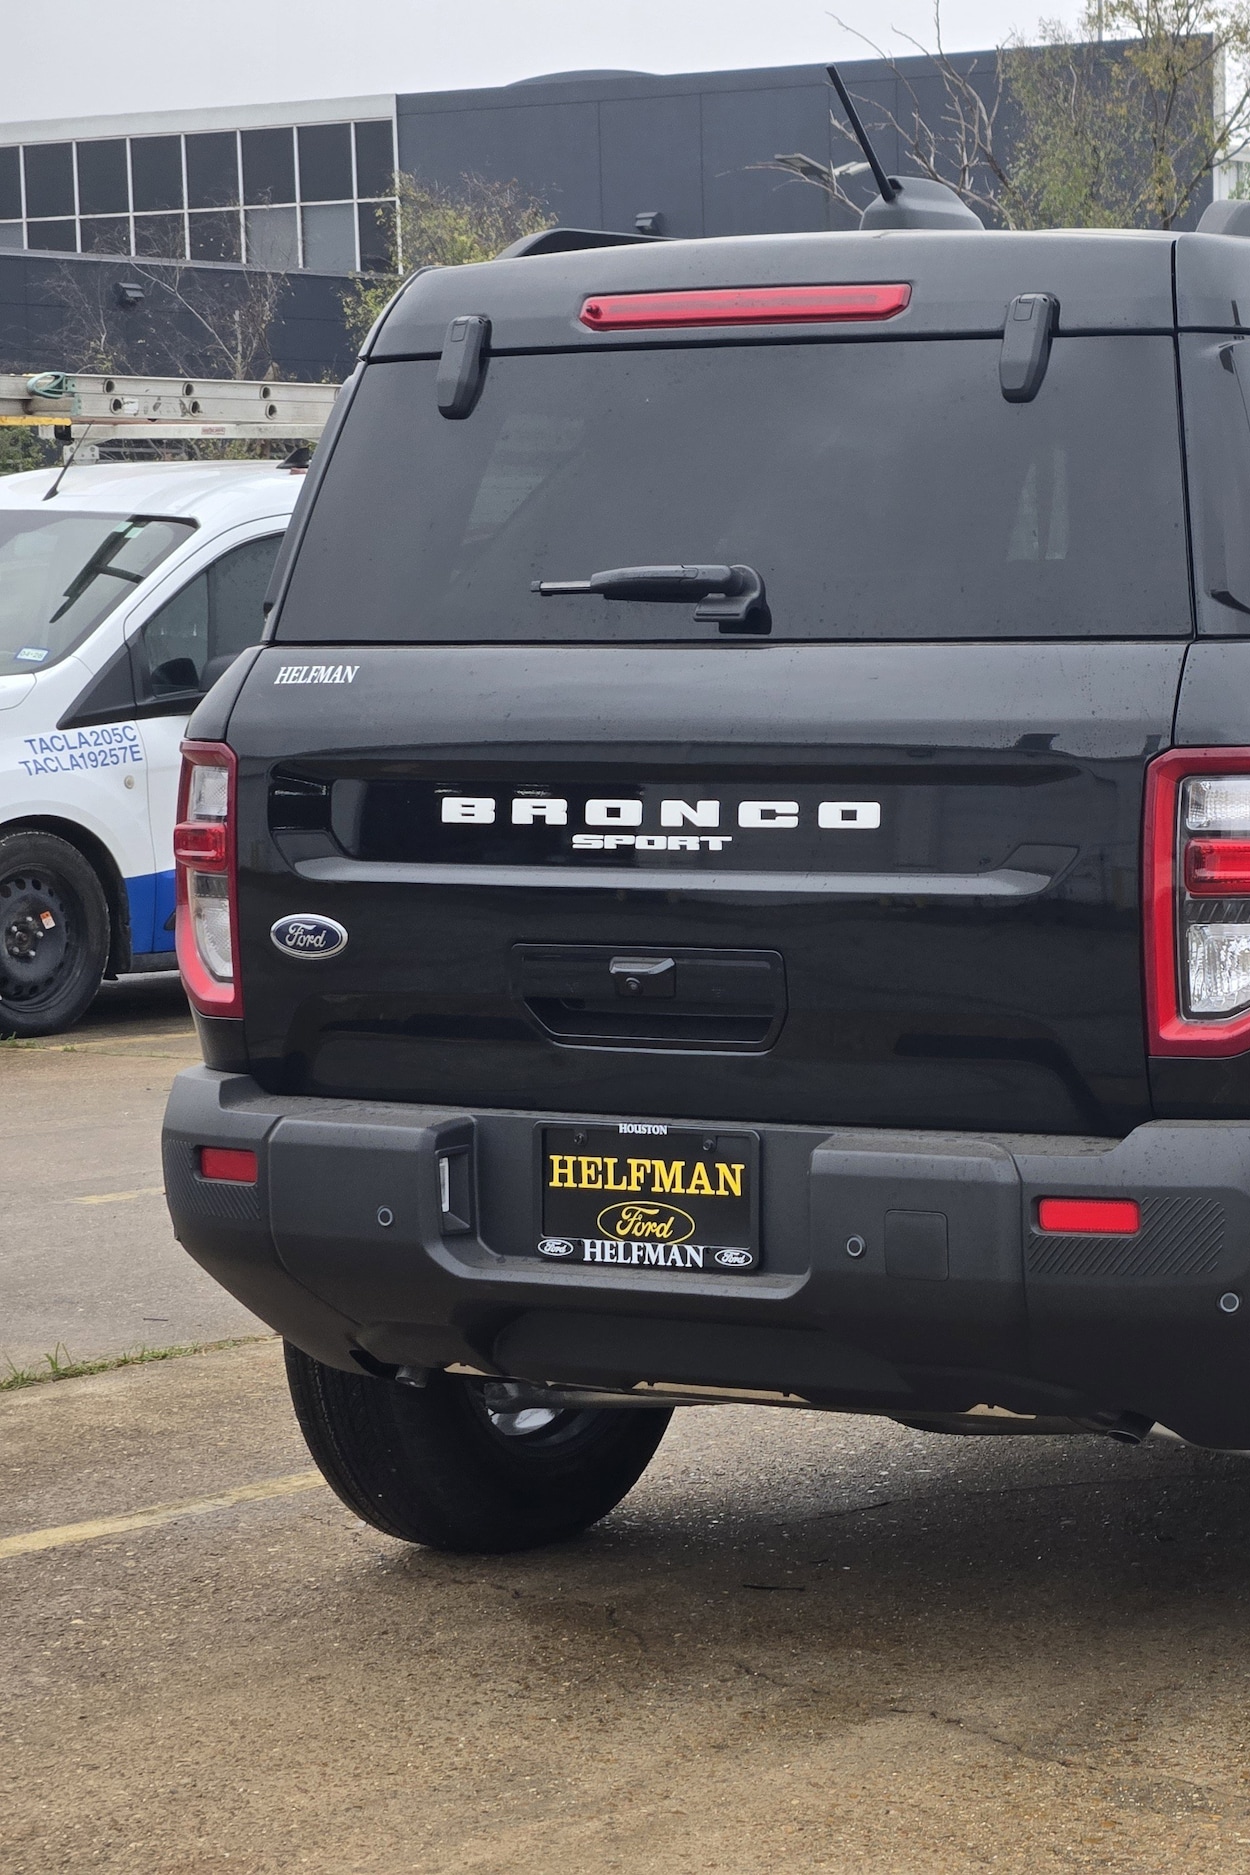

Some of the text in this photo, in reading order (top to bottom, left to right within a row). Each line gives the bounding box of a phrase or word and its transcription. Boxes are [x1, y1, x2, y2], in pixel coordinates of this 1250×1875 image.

[274, 665, 360, 684] HELFMAN
[24, 725, 137, 755] TACLA205C
[18, 744, 143, 776] TACLA19257E
[441, 797, 881, 829] BRONCO
[571, 834, 733, 851] SPORT
[285, 922, 327, 948] Ford
[618, 1122, 668, 1135] HOUSTON
[548, 1155, 745, 1196] HELFMAN
[615, 1205, 675, 1239] Ford
[543, 1241, 568, 1254] Ford
[583, 1238, 705, 1269] HELFMAN
[720, 1251, 746, 1264] Ford
